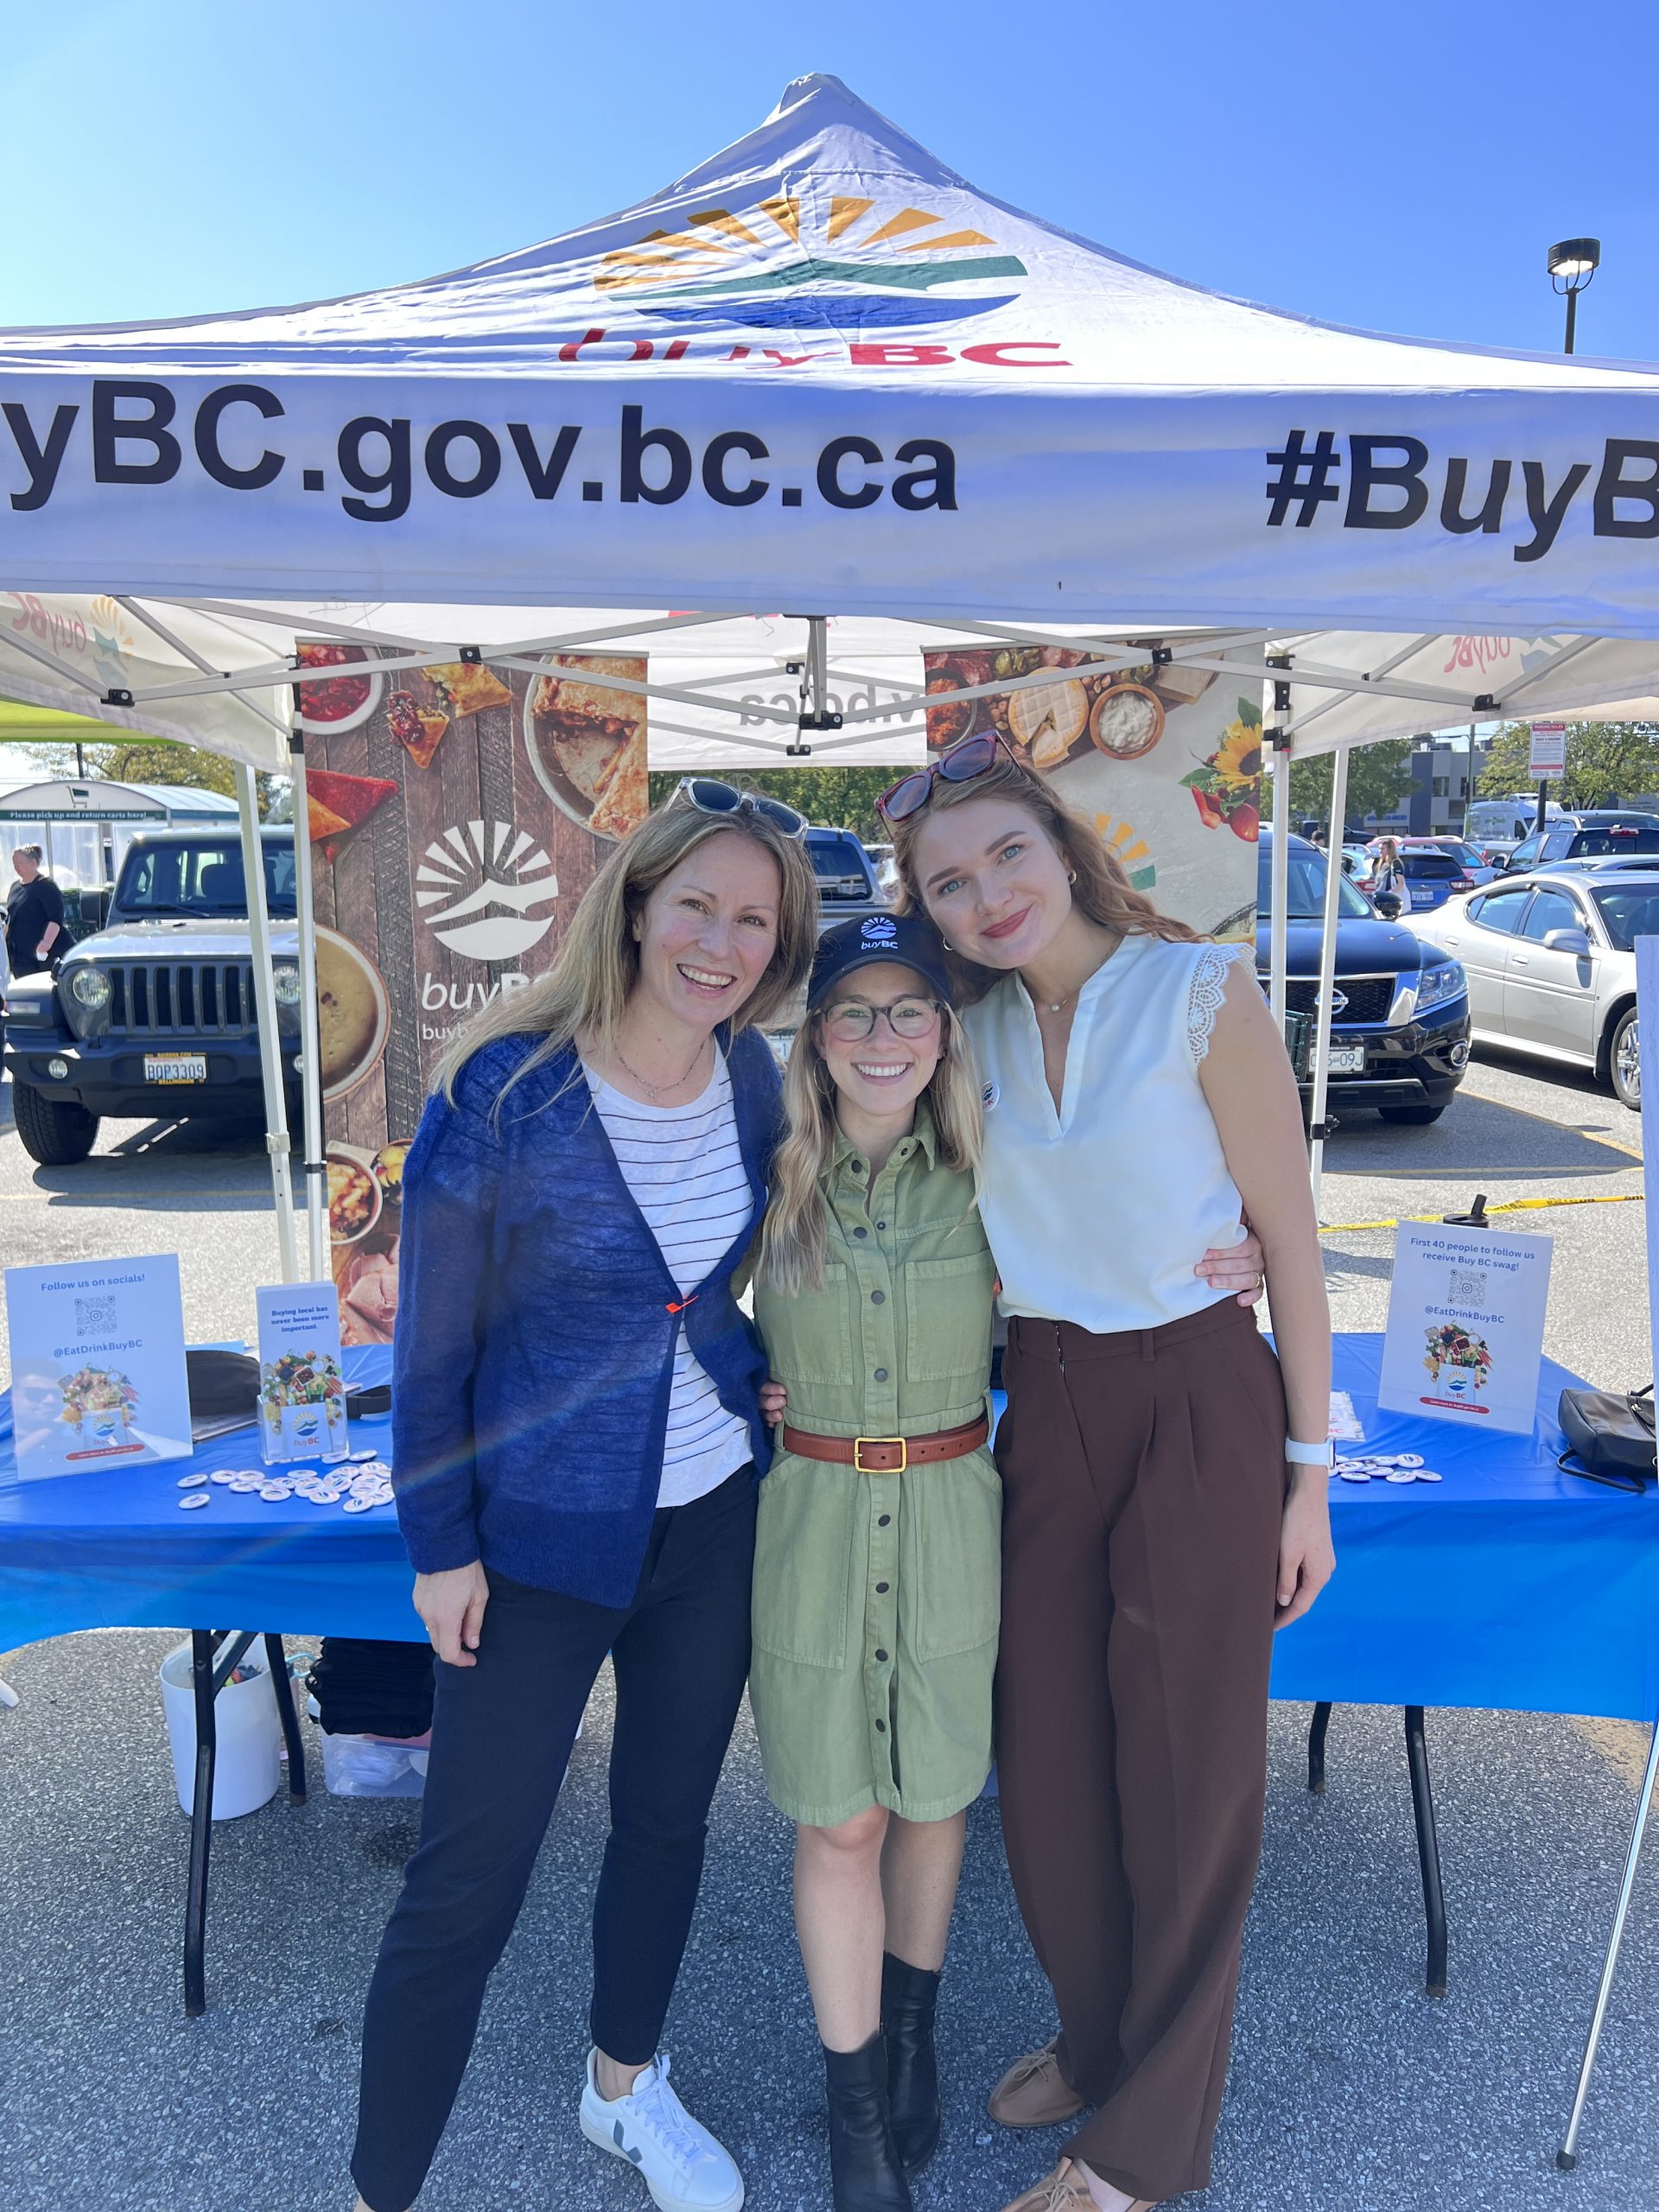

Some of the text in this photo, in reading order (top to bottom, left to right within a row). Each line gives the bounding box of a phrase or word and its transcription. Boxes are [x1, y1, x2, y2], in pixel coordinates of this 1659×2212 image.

[36, 812, 53, 821] pick
[861, 940, 899, 950] buyBC
[1410, 1237, 1431, 1247] First
[1433, 1240, 1445, 1249] 40
[1446, 1242, 1478, 1253] people
[1481, 1245, 1491, 1254] to
[1492, 1247, 1522, 1257] follow
[1422, 1253, 1519, 1272] receive Buy BC swag!
[41, 1281, 76, 1292] Follow
[107, 1274, 145, 1286] socials!
[1425, 1306, 1505, 1324] @EatDrinkBuyBC
[54, 1339, 143, 1358] @EatDrinkBuyBC
[294, 1436, 320, 1447] buyBC
